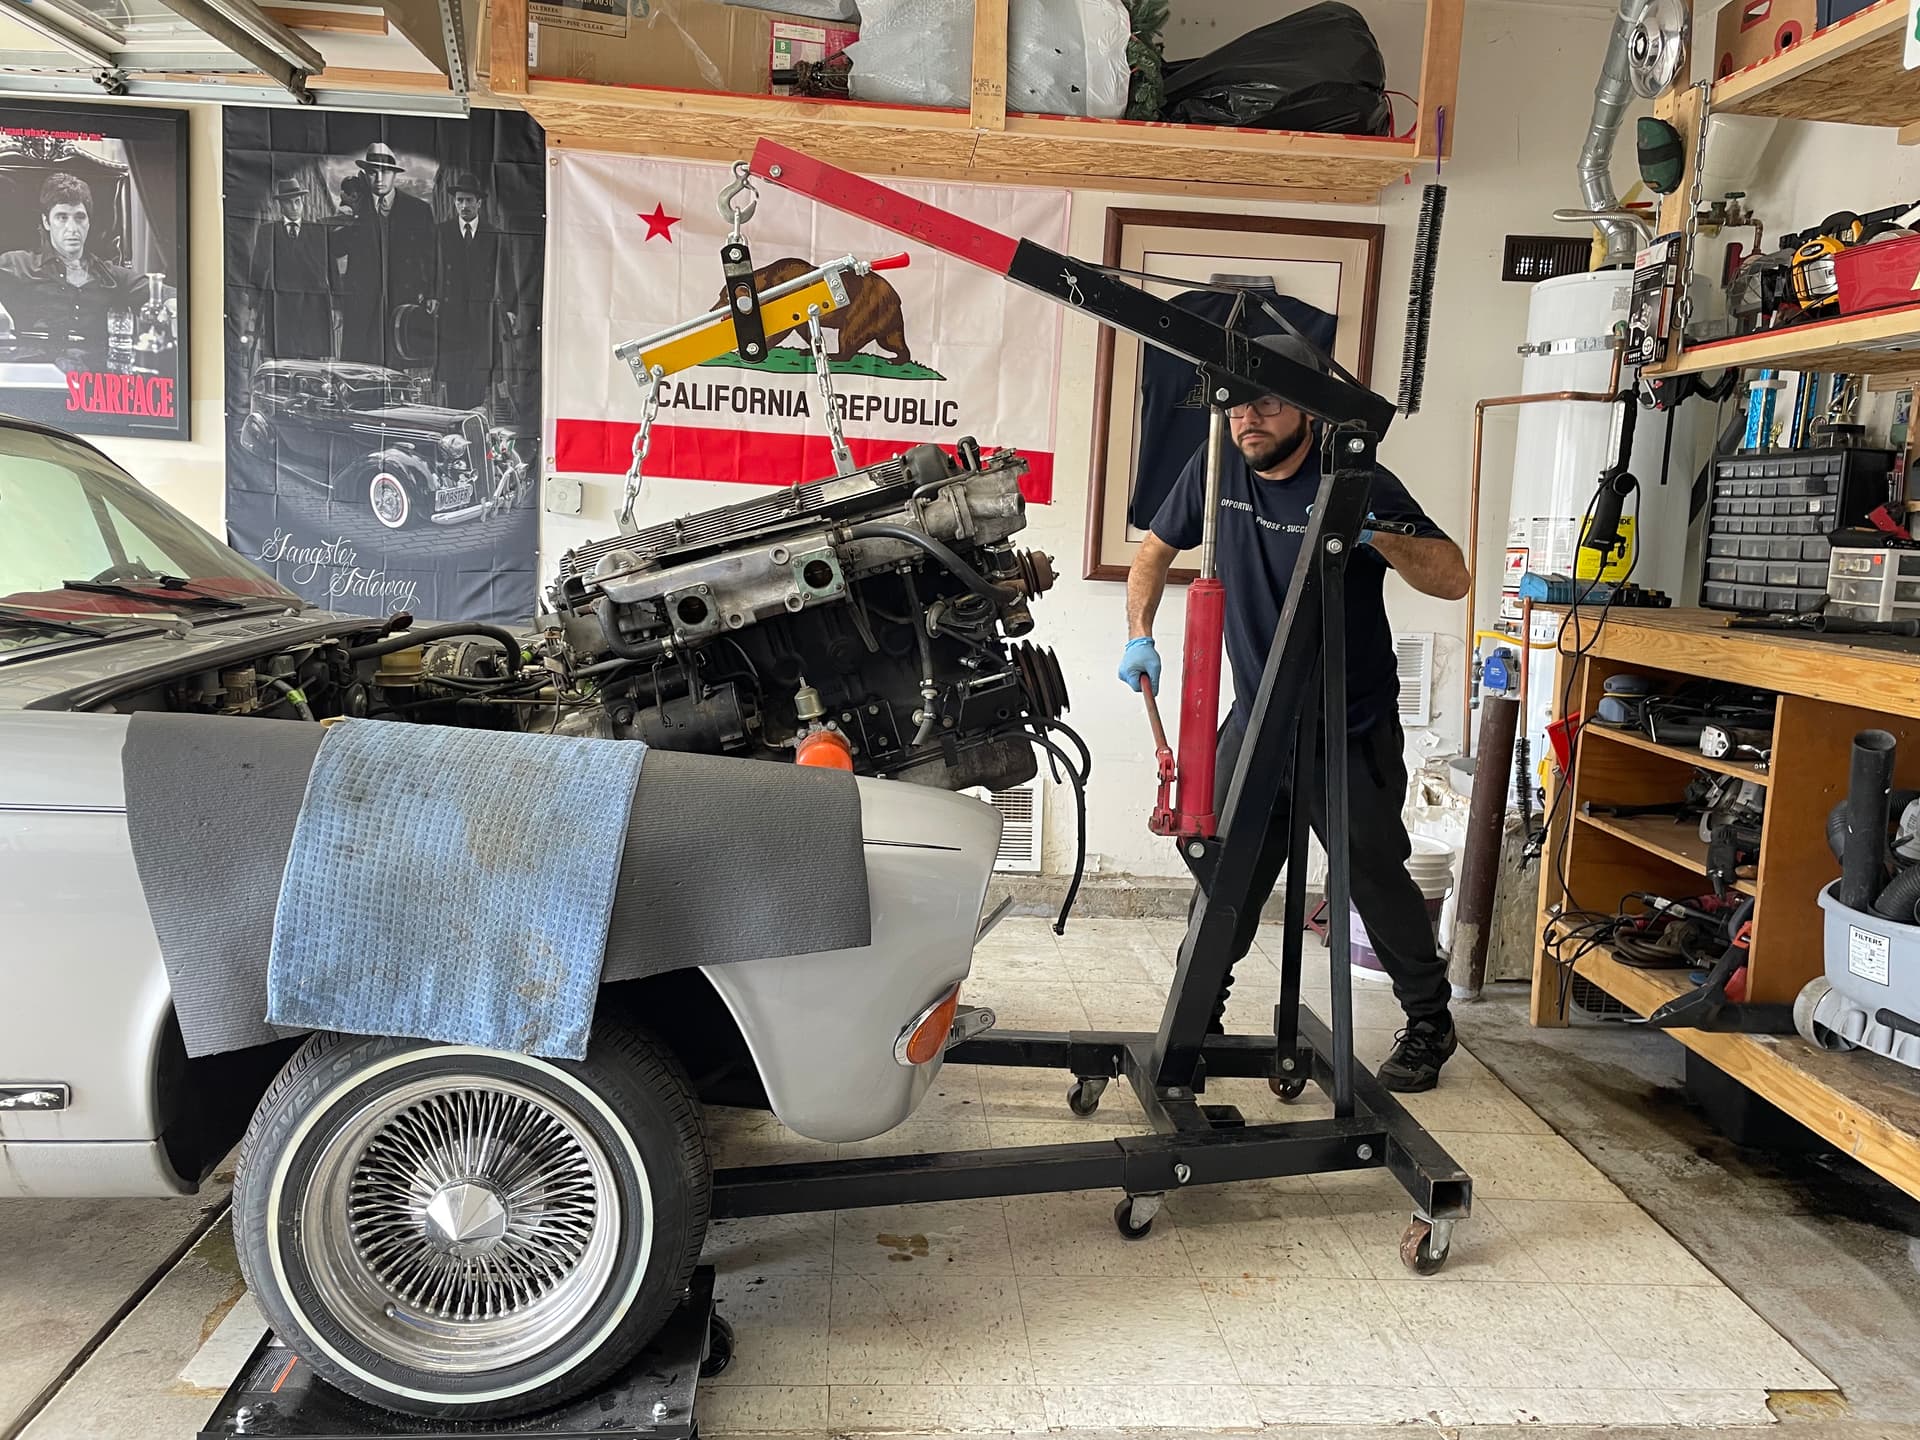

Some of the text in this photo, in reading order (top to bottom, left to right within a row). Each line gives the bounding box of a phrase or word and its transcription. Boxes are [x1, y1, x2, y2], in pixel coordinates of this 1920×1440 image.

[66, 371, 174, 418] SCARFACE
[657, 381, 959, 426] CALIFORNIA REPUBLIC
[255, 528, 358, 585] Gangster
[322, 562, 421, 615] Gateway
[1855, 932, 1882, 945] FILTERS
